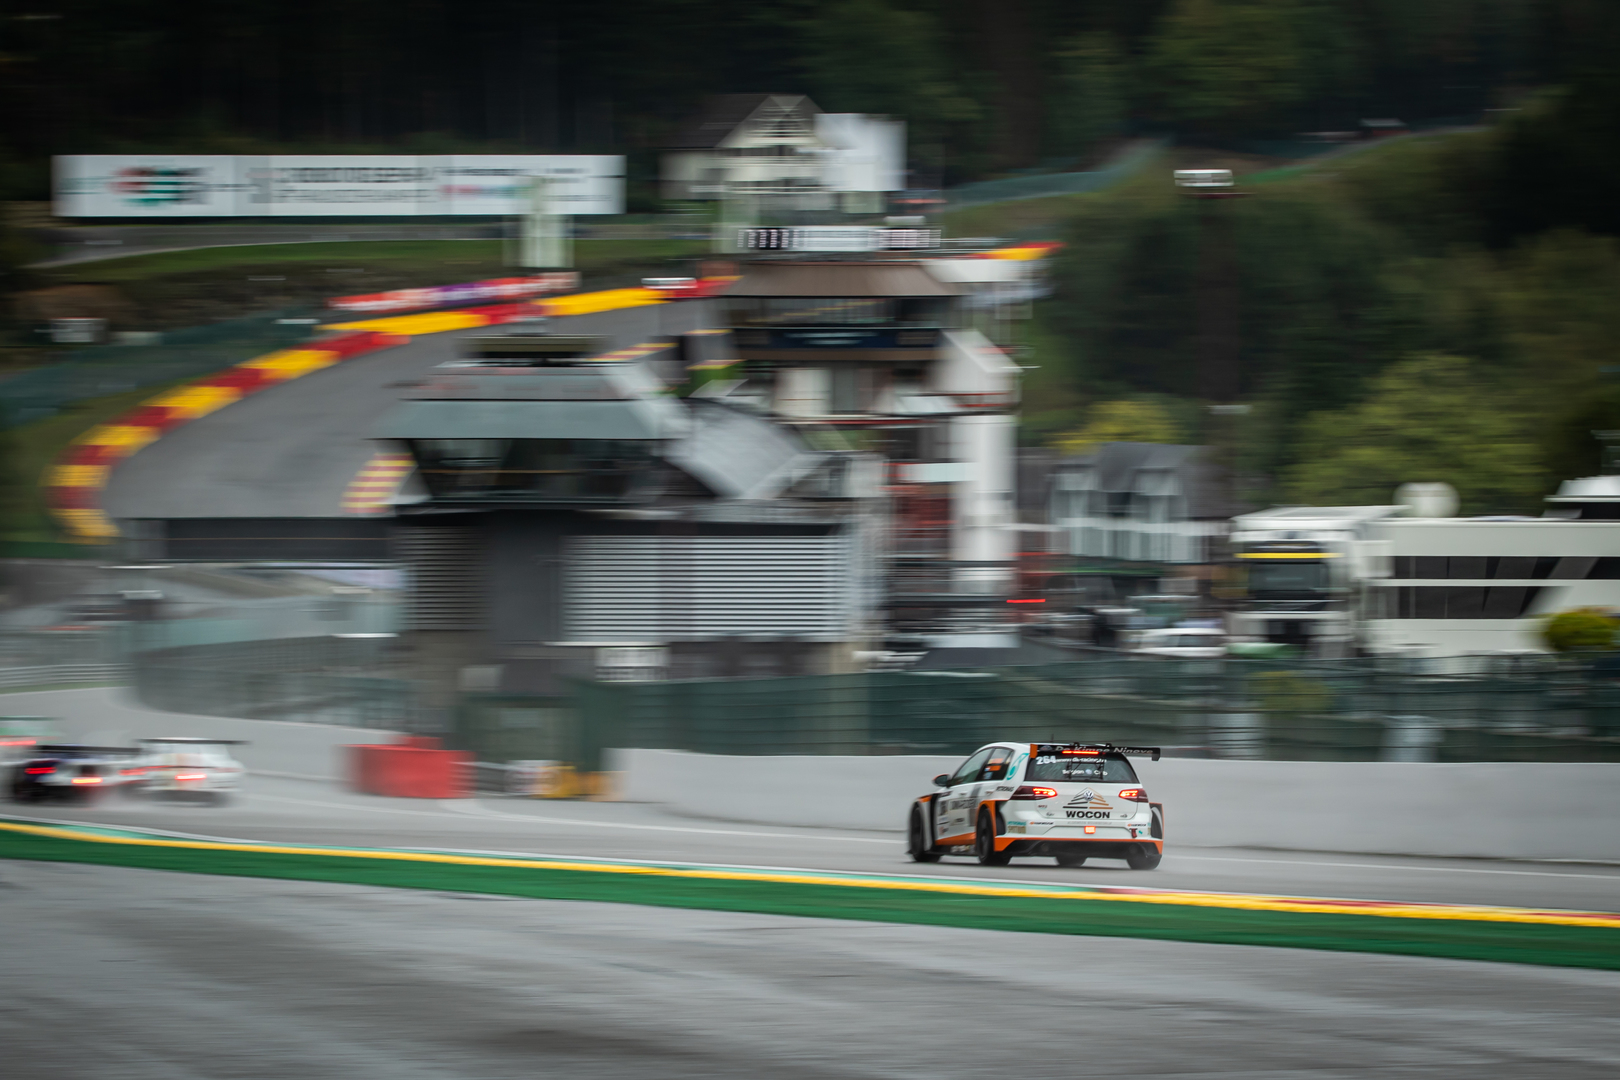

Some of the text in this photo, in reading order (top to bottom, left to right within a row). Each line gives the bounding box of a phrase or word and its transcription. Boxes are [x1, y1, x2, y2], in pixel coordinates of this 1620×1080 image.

[1113, 746, 1154, 754] Ninove
[1035, 755, 1057, 765] 264
[1066, 810, 1110, 819] WOCON
